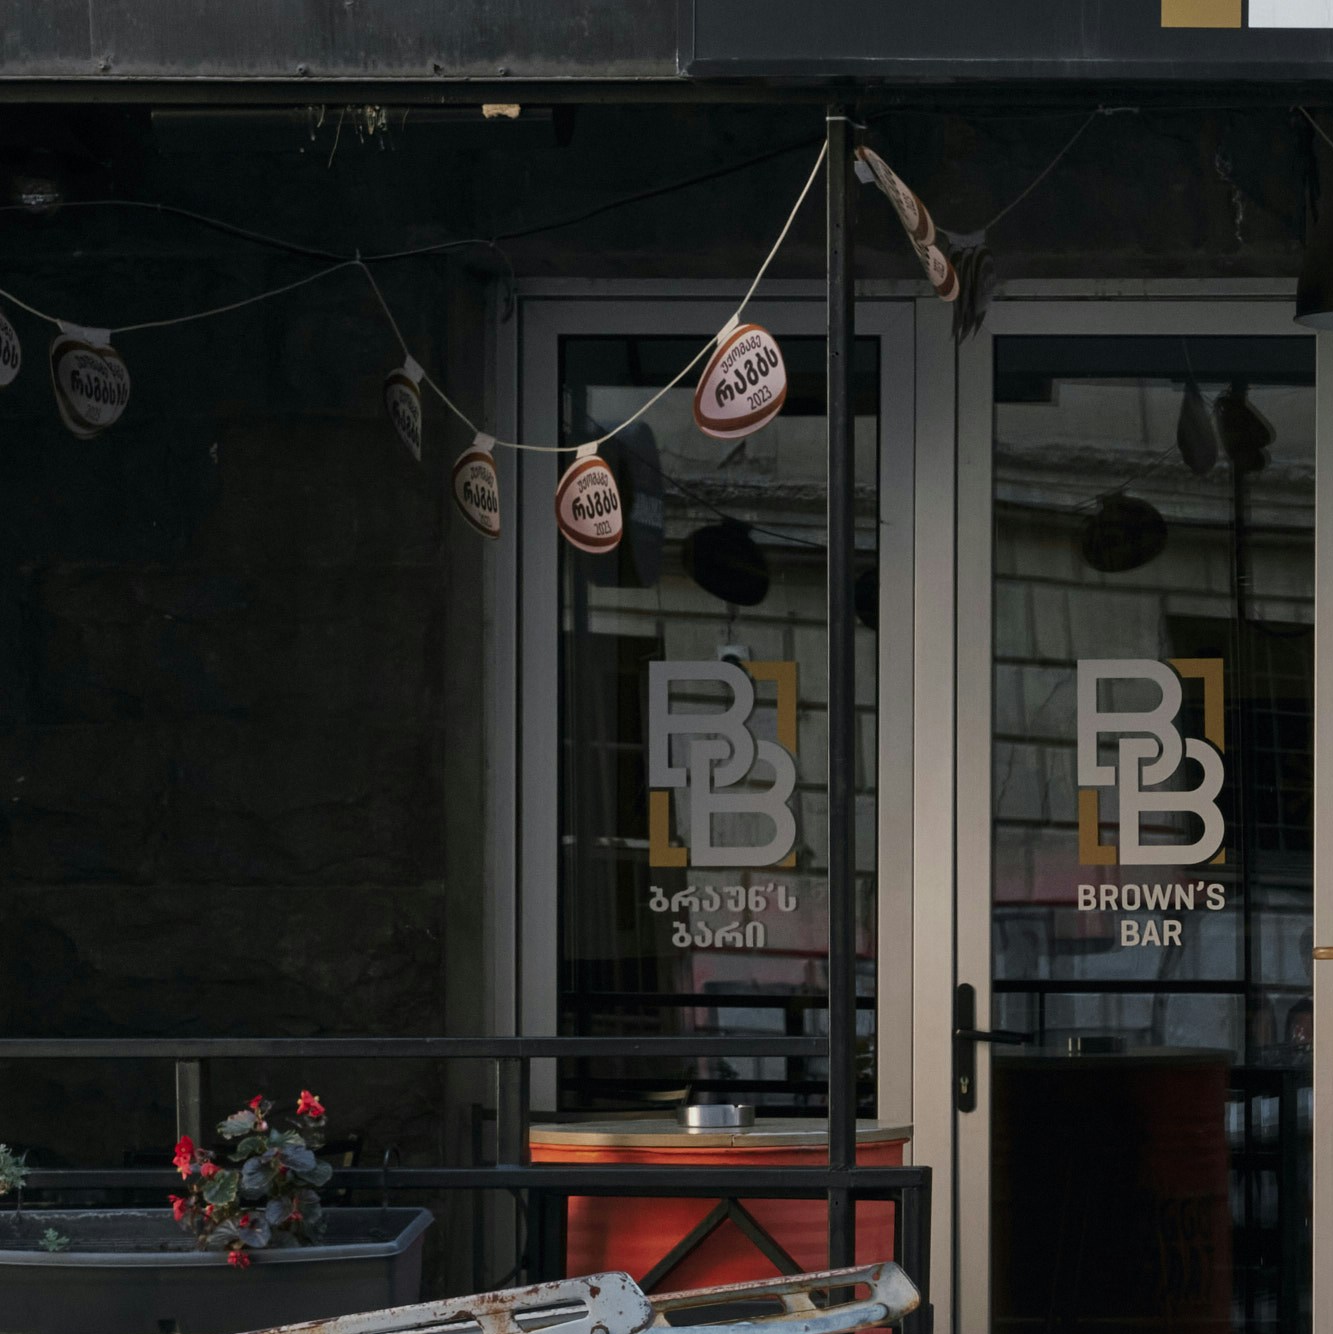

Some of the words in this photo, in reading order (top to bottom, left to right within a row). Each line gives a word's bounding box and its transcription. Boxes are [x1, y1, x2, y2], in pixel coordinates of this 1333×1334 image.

[715, 345, 779, 408] რაგბს
[747, 385, 773, 410] 2023
[1077, 882, 1226, 911] BROWN'S
[671, 921, 765, 948] ბარი
[1120, 920, 1182, 947] BAR
